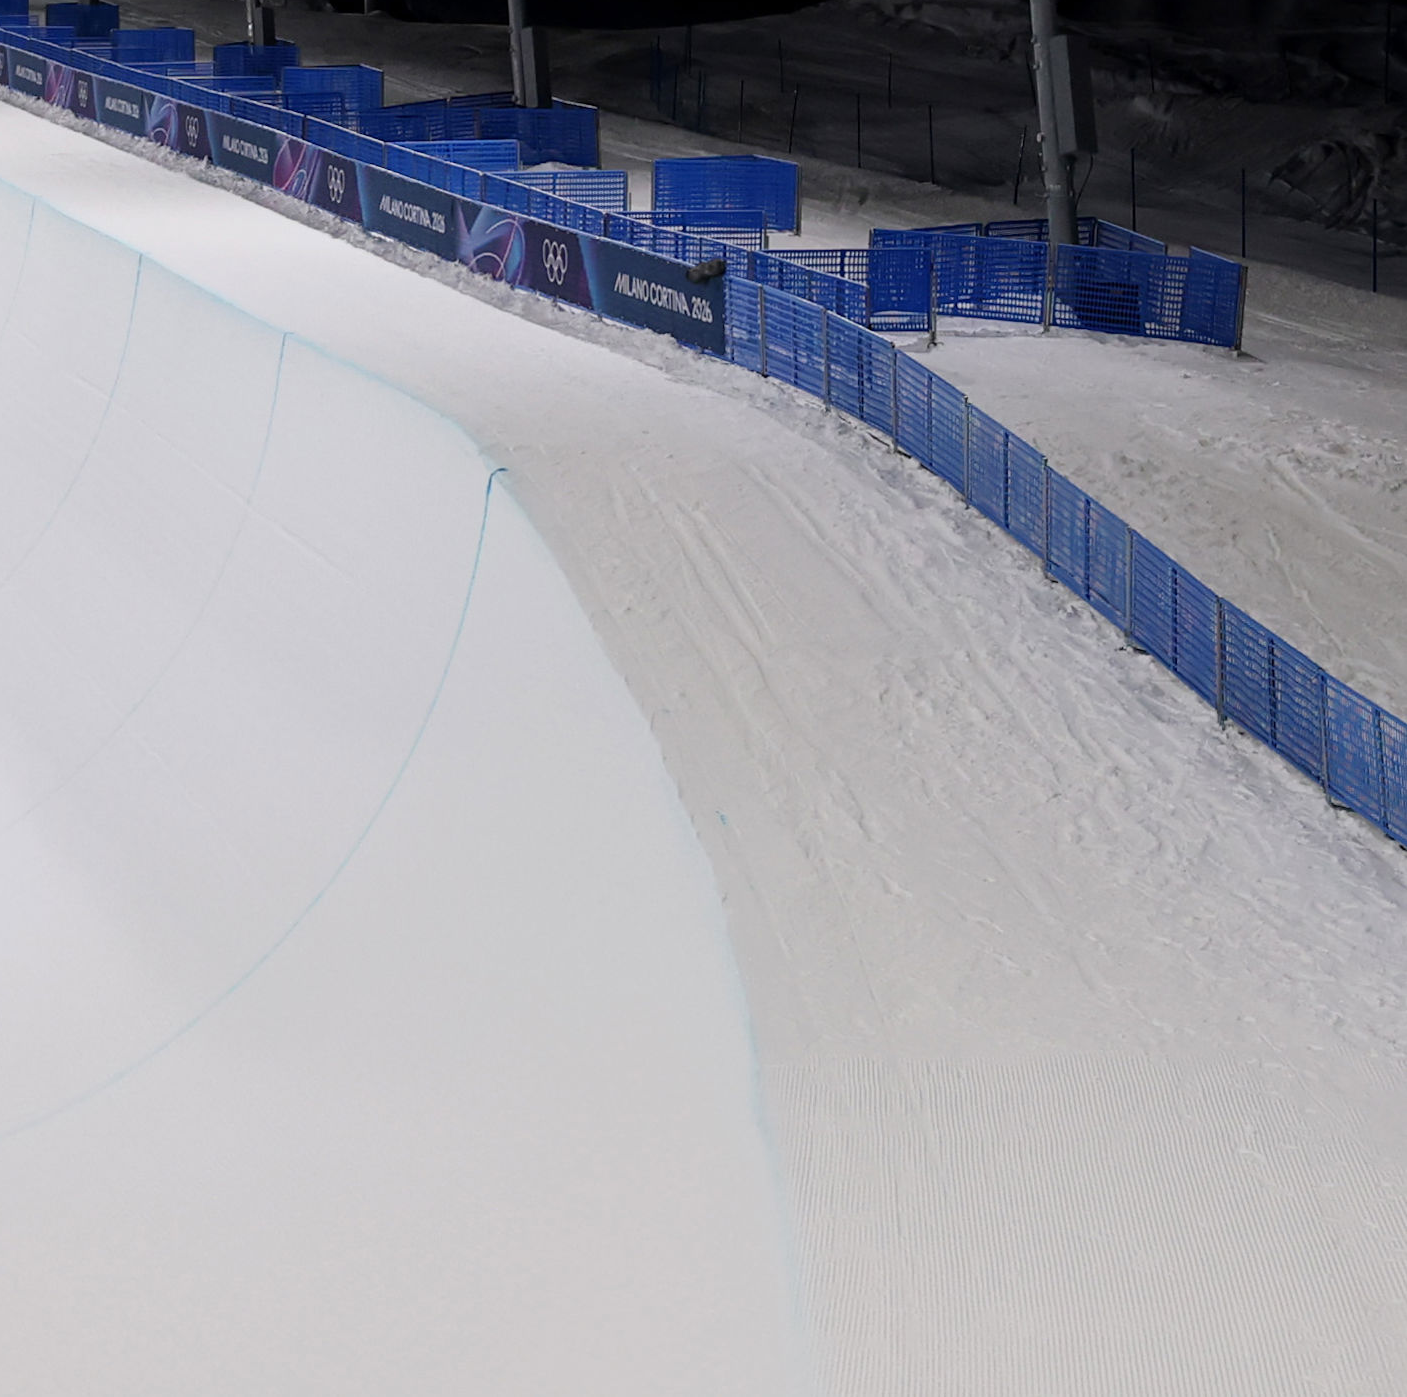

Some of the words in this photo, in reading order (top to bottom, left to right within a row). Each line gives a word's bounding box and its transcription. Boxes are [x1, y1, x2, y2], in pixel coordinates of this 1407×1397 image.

[614, 272, 649, 303] MILANO
[650, 282, 690, 316] CORTINA
[691, 295, 713, 323] 2026
